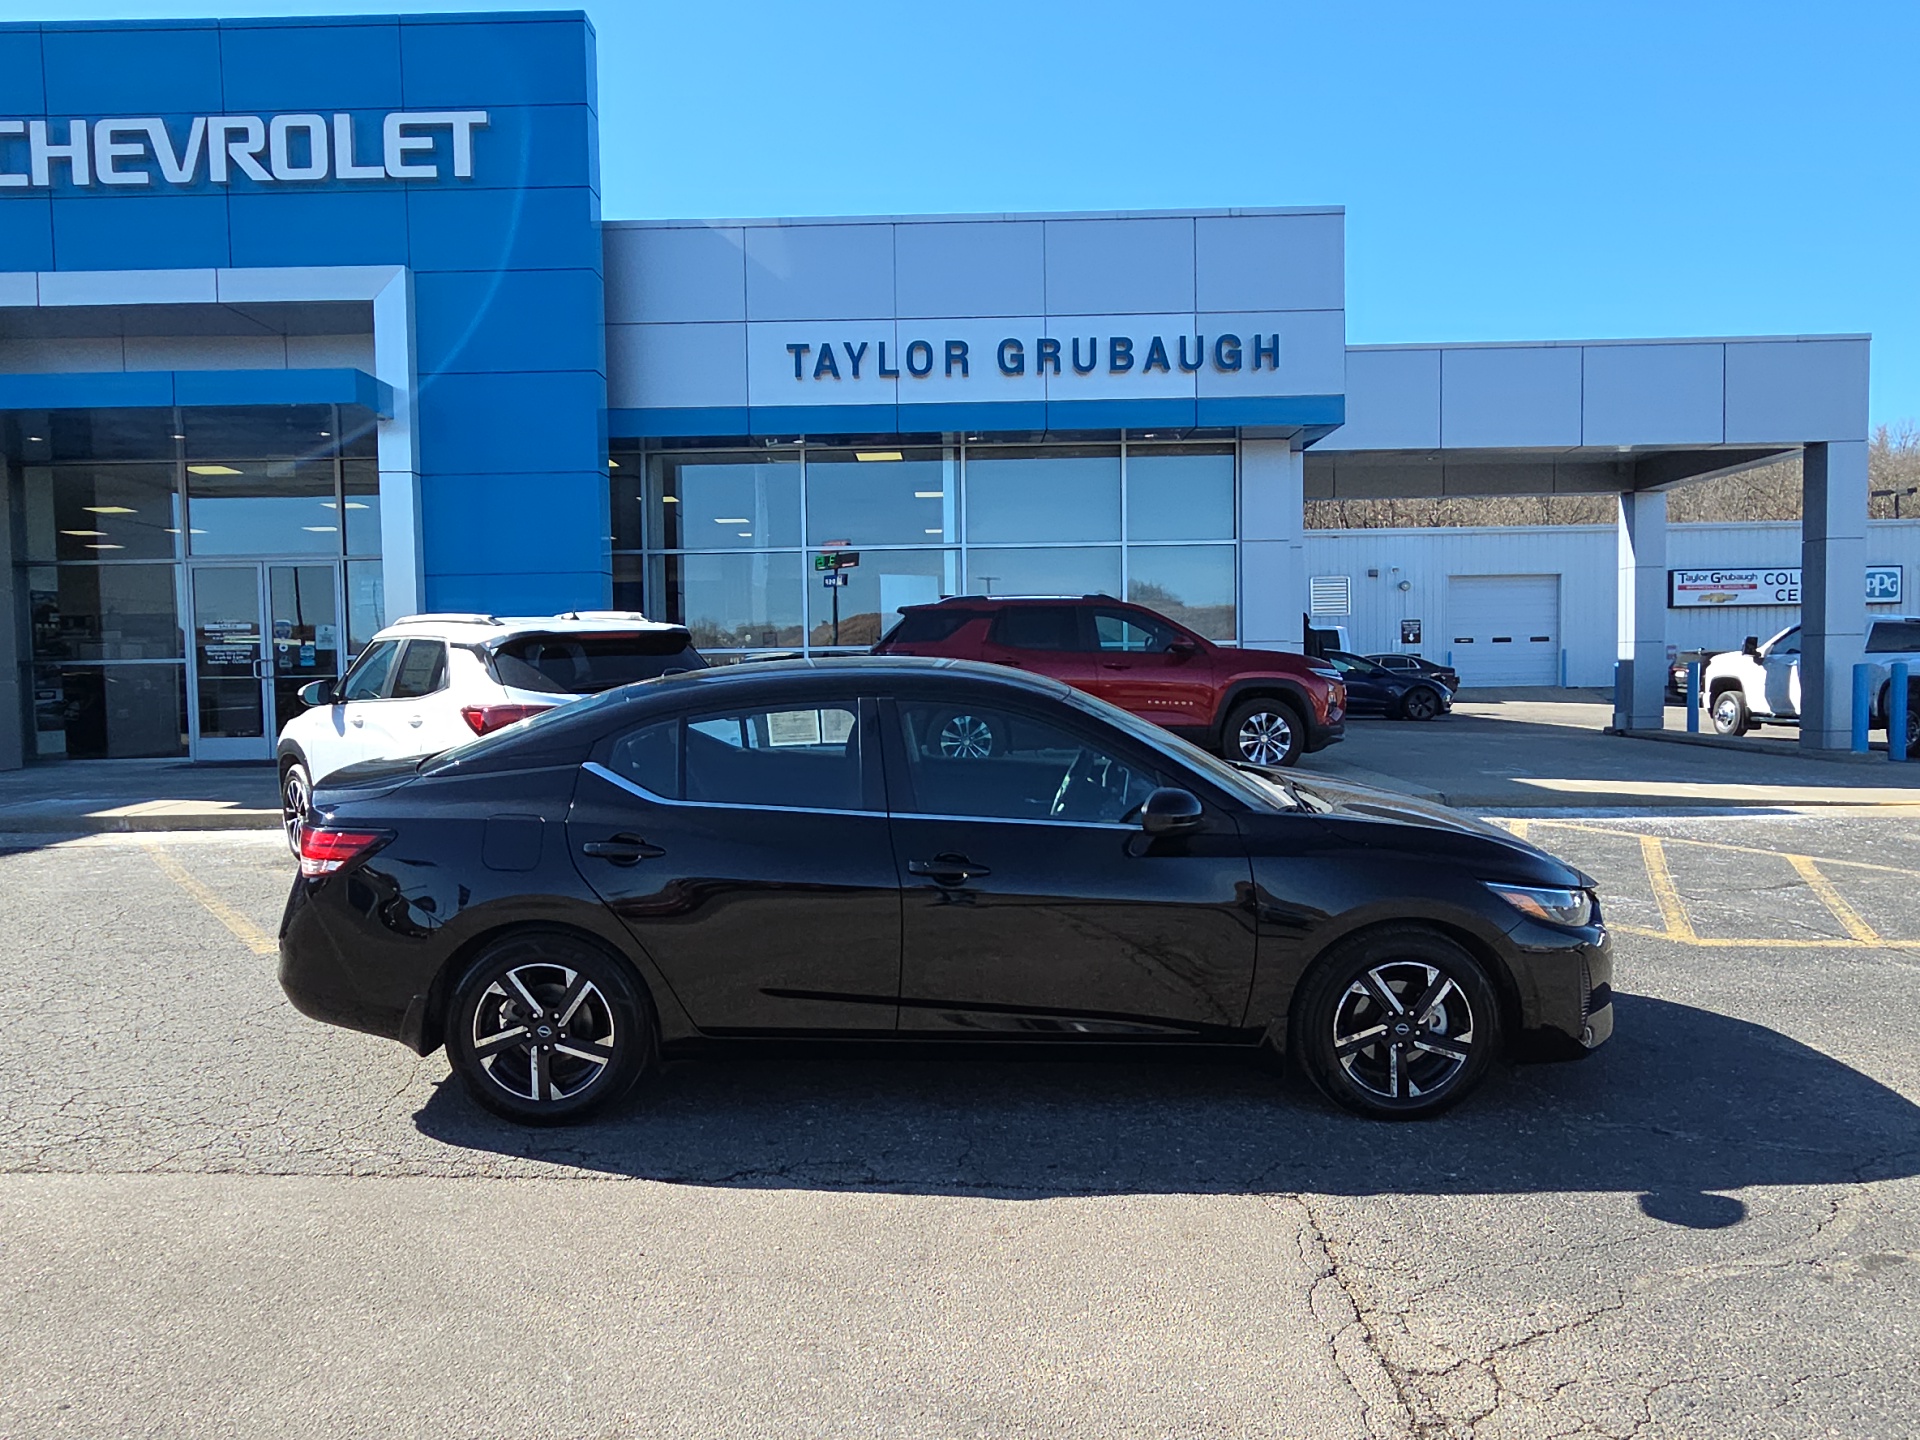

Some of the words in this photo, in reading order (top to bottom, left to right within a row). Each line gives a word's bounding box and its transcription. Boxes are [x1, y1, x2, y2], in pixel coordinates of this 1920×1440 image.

[786, 340, 970, 380] TAYLOR
[997, 333, 1281, 375] GRUBAUGH
[1677, 572, 1709, 584] Taylor
[1710, 572, 1758, 583] Grubaugh
